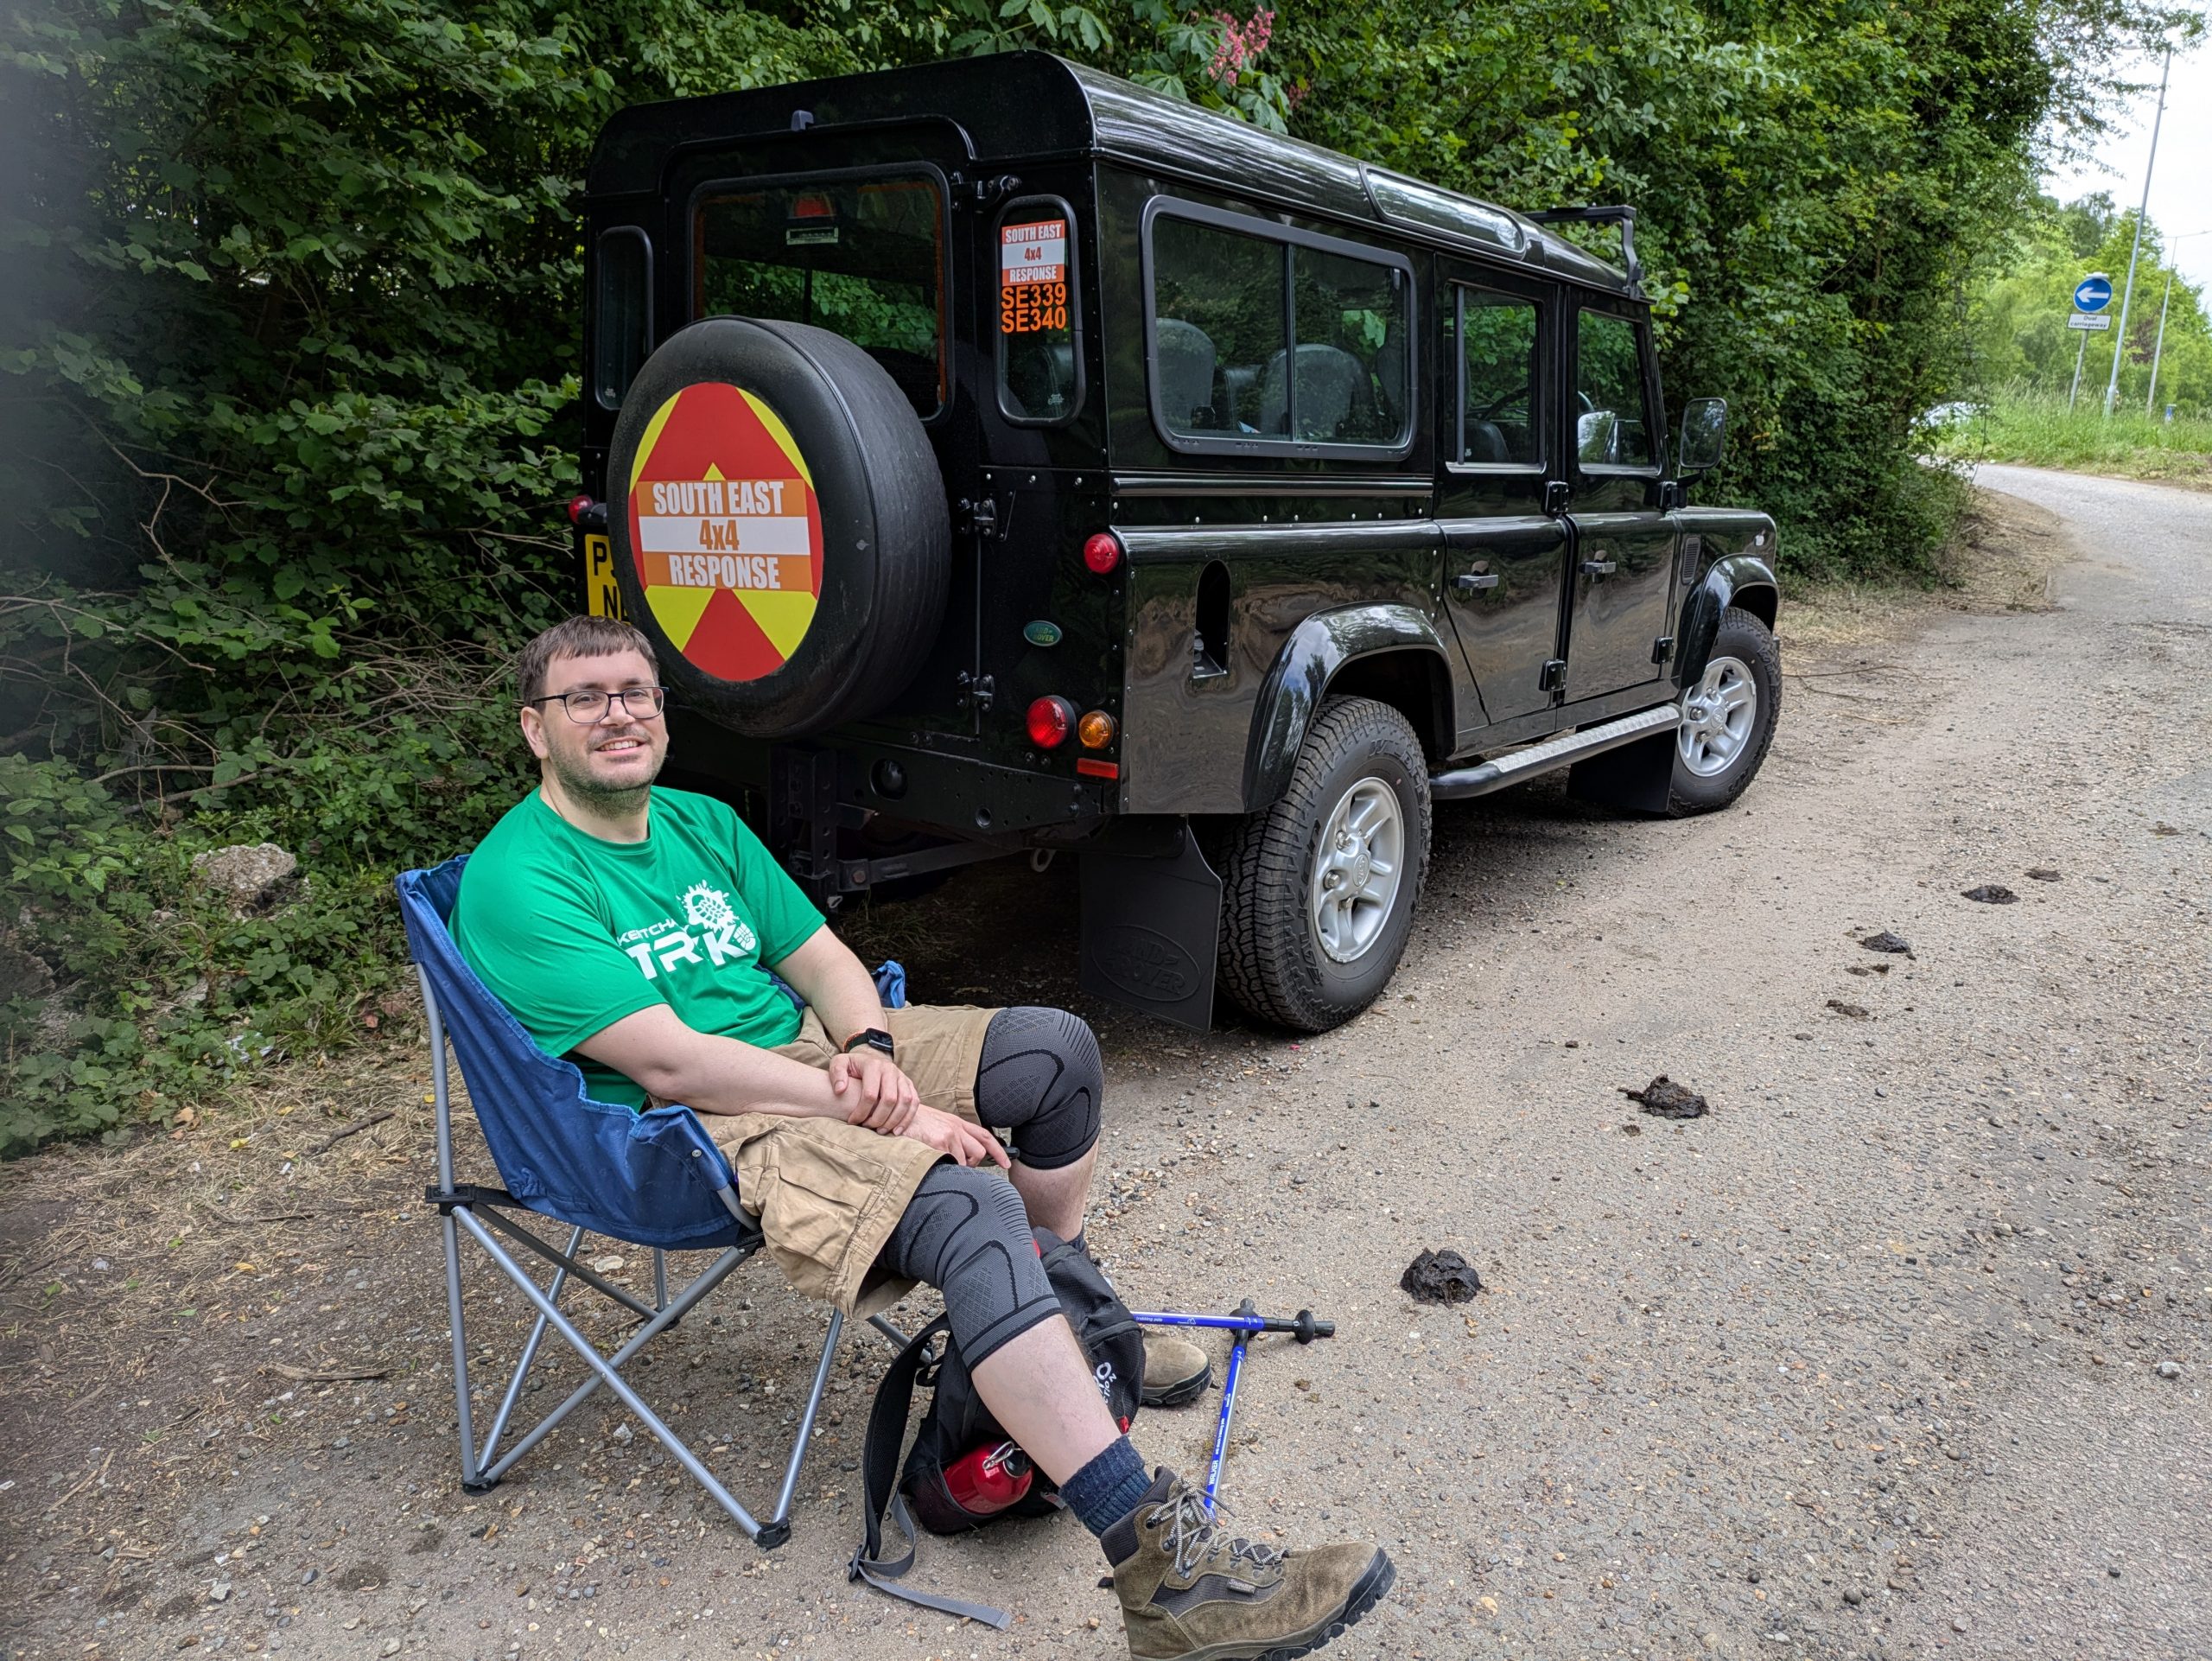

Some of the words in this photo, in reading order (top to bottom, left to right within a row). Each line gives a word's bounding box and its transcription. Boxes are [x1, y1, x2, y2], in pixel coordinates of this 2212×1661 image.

[1005, 226, 1036, 243] SOUTH
[1038, 223, 1061, 239] EAST
[1024, 246, 1042, 261] 4x4
[1009, 265, 1057, 283] RESPONSE
[1001, 283, 1066, 309] SE339
[1001, 306, 1066, 334] SE340
[652, 482, 721, 515] SOUTH
[728, 480, 785, 514] EAST
[698, 519, 741, 551] 4x4
[668, 554, 781, 589] RESPONSE
[1208, 1460, 1219, 1486] WALKER
